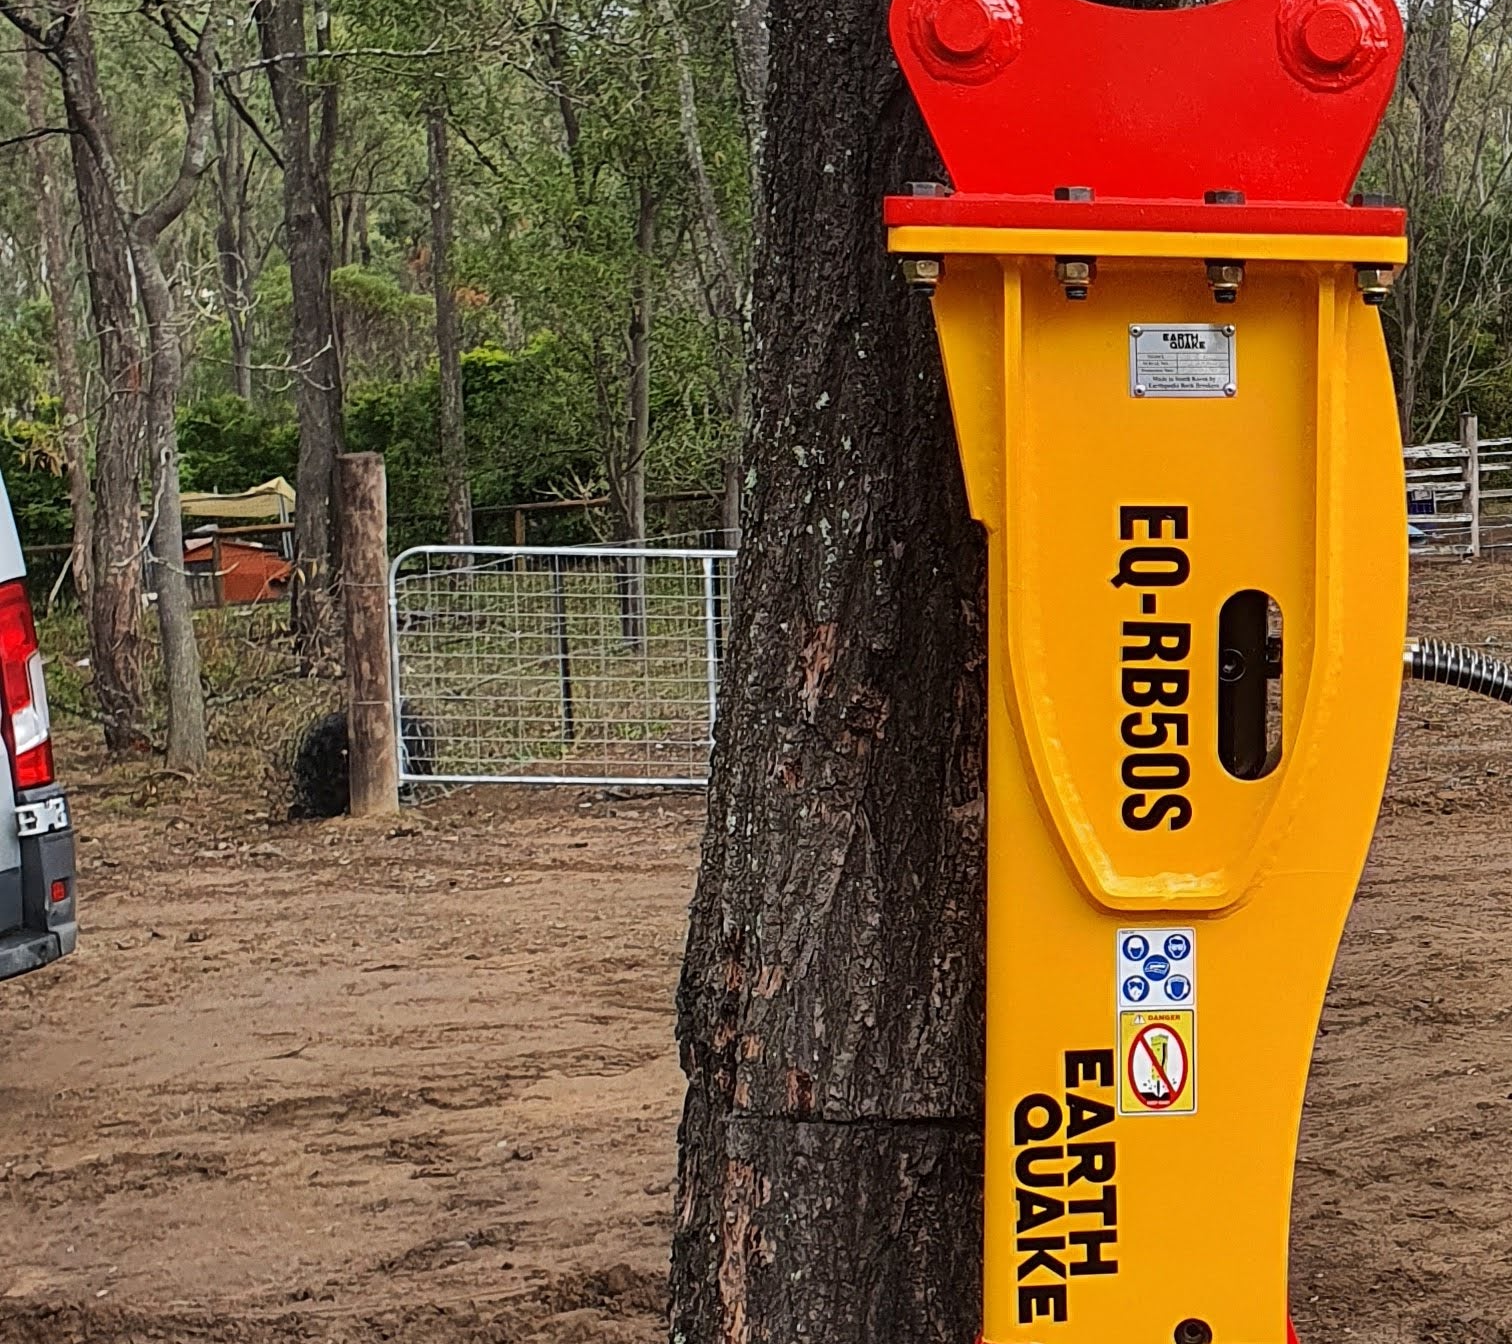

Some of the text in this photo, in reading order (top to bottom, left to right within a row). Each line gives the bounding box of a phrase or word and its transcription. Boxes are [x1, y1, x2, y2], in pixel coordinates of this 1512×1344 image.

[1163, 333, 1198, 342] EARTH
[1169, 341, 1206, 349] QUAKE
[1107, 505, 1193, 831] EQ-RB50S
[1013, 1093, 1068, 1324] QUAKE
[1063, 1048, 1118, 1276] EARTH
